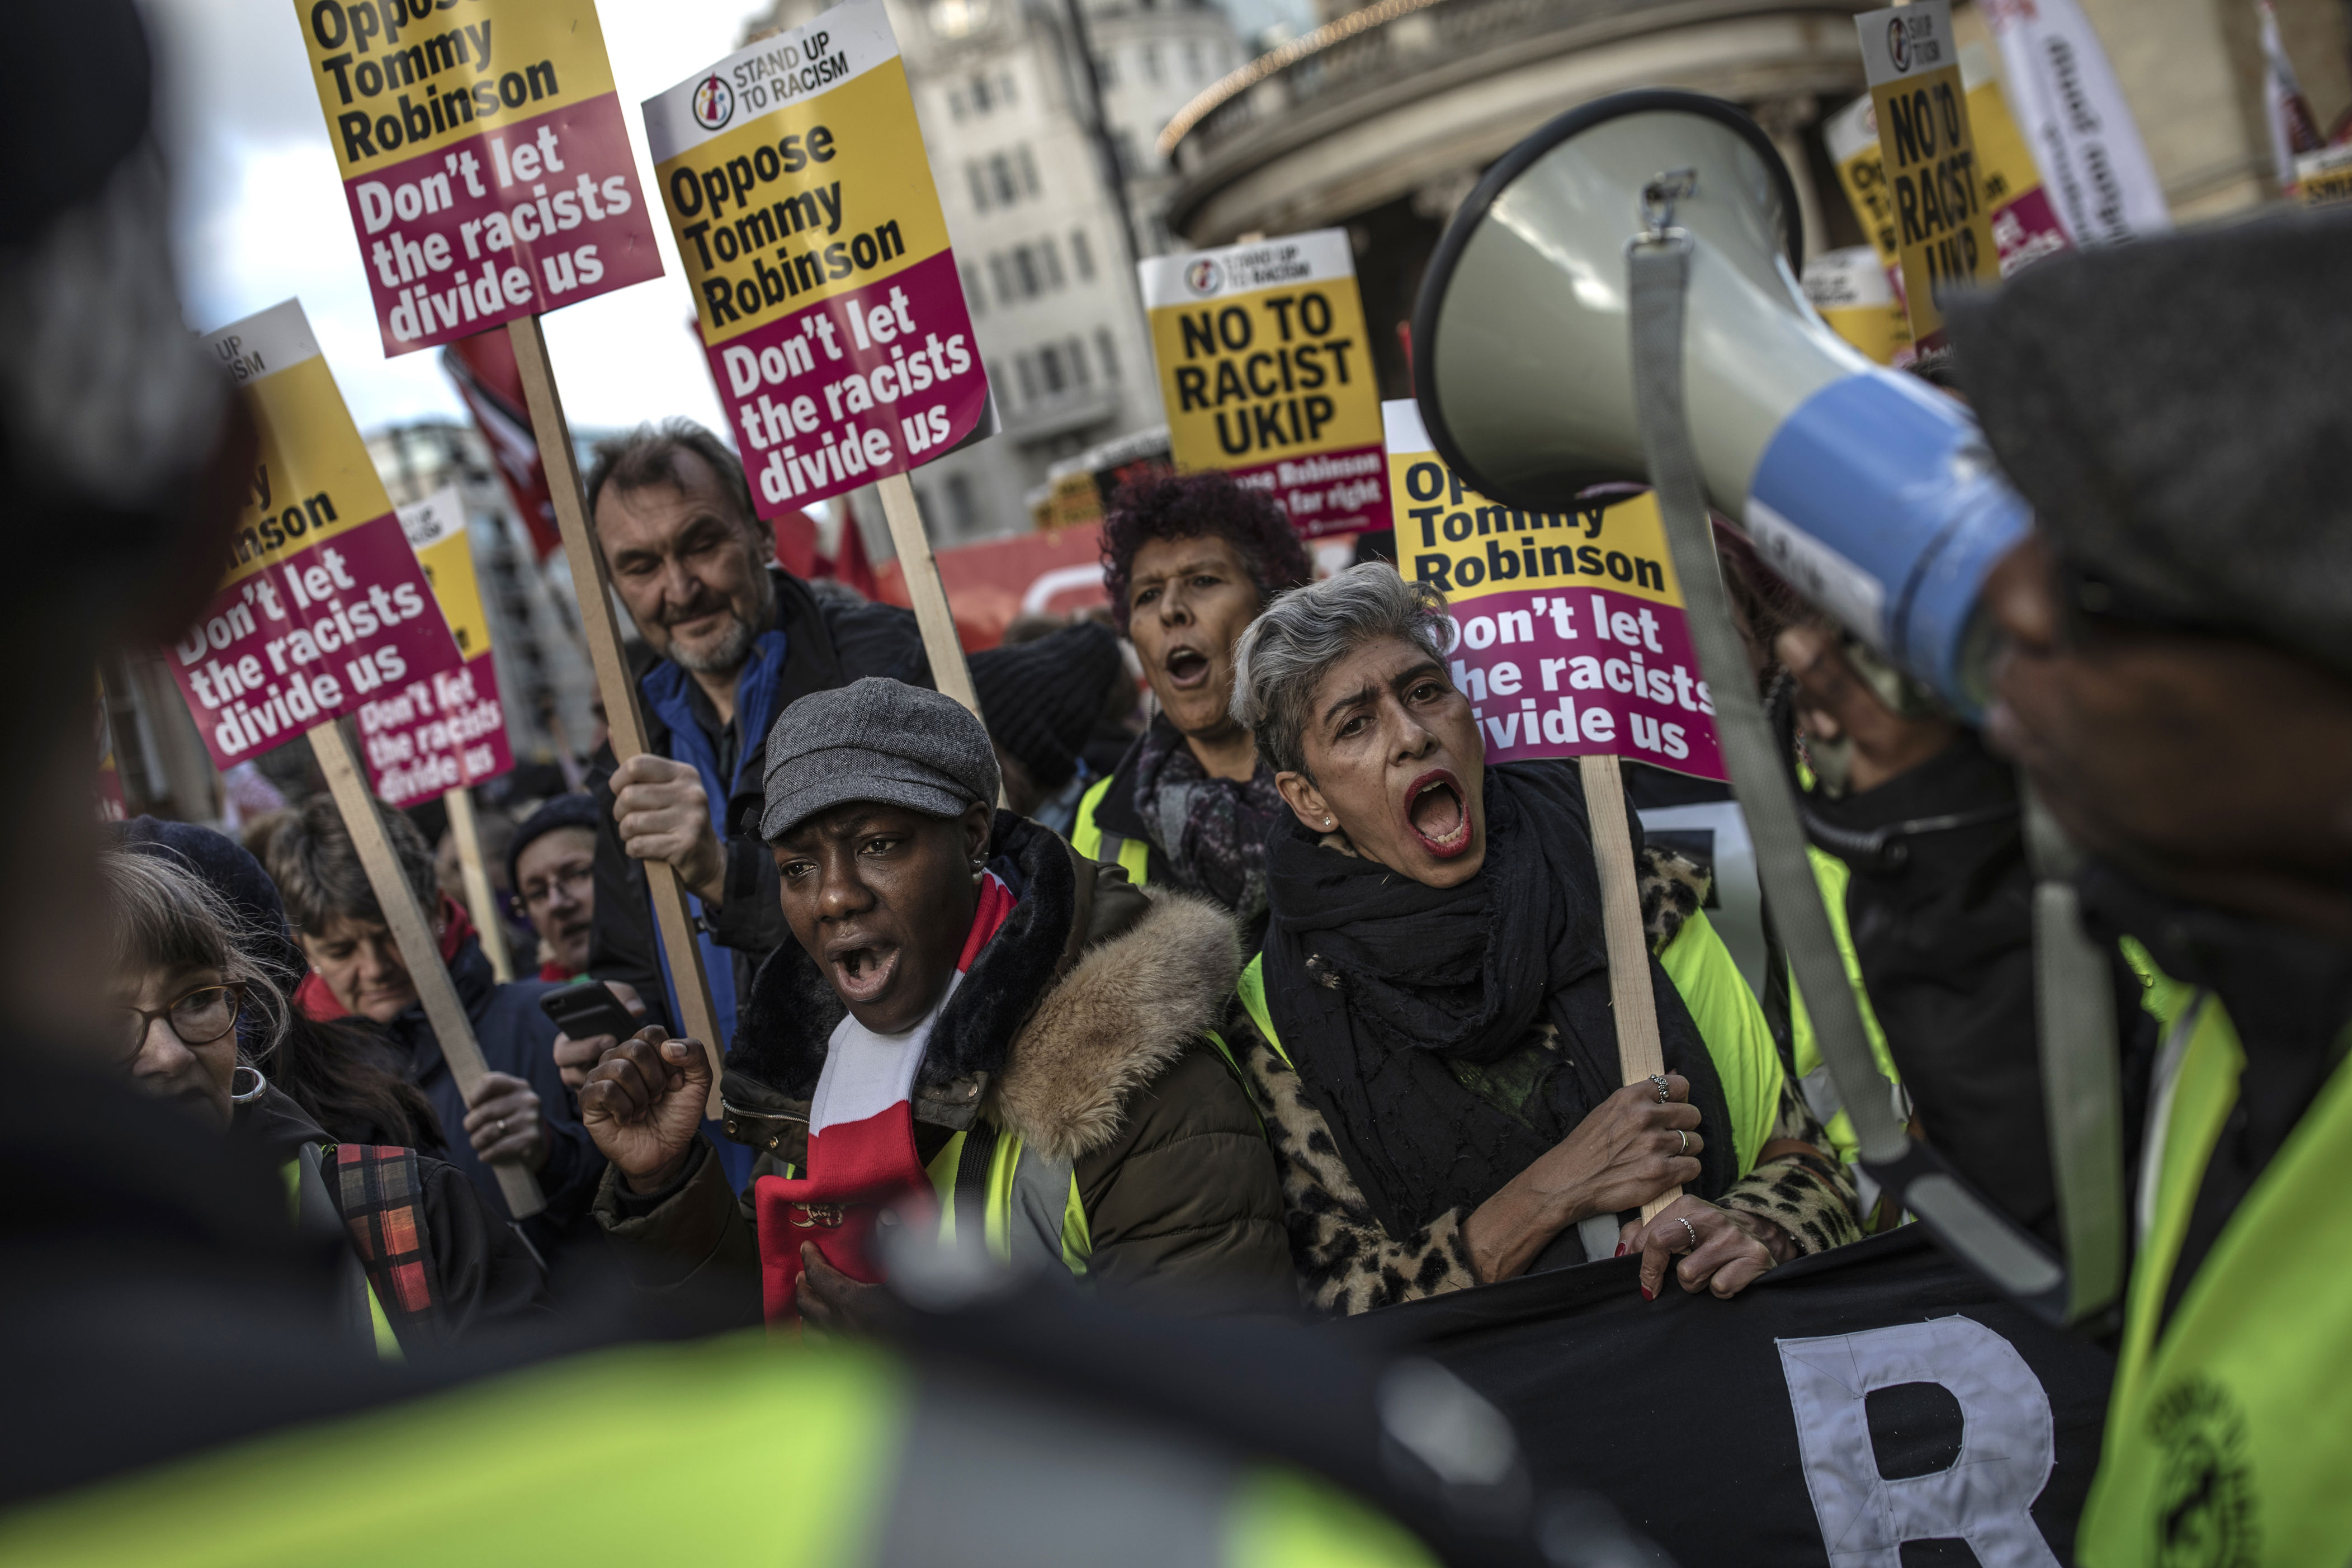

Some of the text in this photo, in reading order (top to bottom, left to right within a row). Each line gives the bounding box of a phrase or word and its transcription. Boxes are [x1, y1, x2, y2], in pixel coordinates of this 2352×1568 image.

[311, 0, 475, 54] Oppo
[322, 20, 492, 106] Tommy
[733, 30, 830, 88] STAND UP
[338, 59, 559, 163] Robinson
[739, 51, 849, 113] TO RACISM
[1889, 88, 1936, 168] NO
[356, 125, 564, 234] Don't let
[670, 125, 837, 219] Oppose
[372, 173, 632, 289] the racists
[683, 180, 842, 271] Tommy
[389, 244, 604, 342] divide us
[701, 219, 906, 329] Robinson
[214, 335, 242, 361] UP
[722, 285, 916, 399] Don't let
[1178, 291, 1333, 361] NO TO
[228, 350, 266, 382] ISM
[740, 333, 971, 451] the racists
[1173, 338, 1354, 414] RACIST
[759, 404, 951, 504] divide us
[1214, 395, 1335, 457] UKIP
[1277, 452, 1382, 488] Robinson
[284, 547, 356, 609] let
[1415, 536, 1665, 593] Robinson
[188, 582, 424, 710] the racists
[1590, 594, 1663, 654] let
[215, 645, 407, 756] divide us
[358, 666, 476, 734] Don't let
[1451, 650, 1717, 716] he racists
[367, 698, 503, 771] the racists
[1472, 696, 1690, 760] ivide us
[379, 742, 496, 806] divide us
